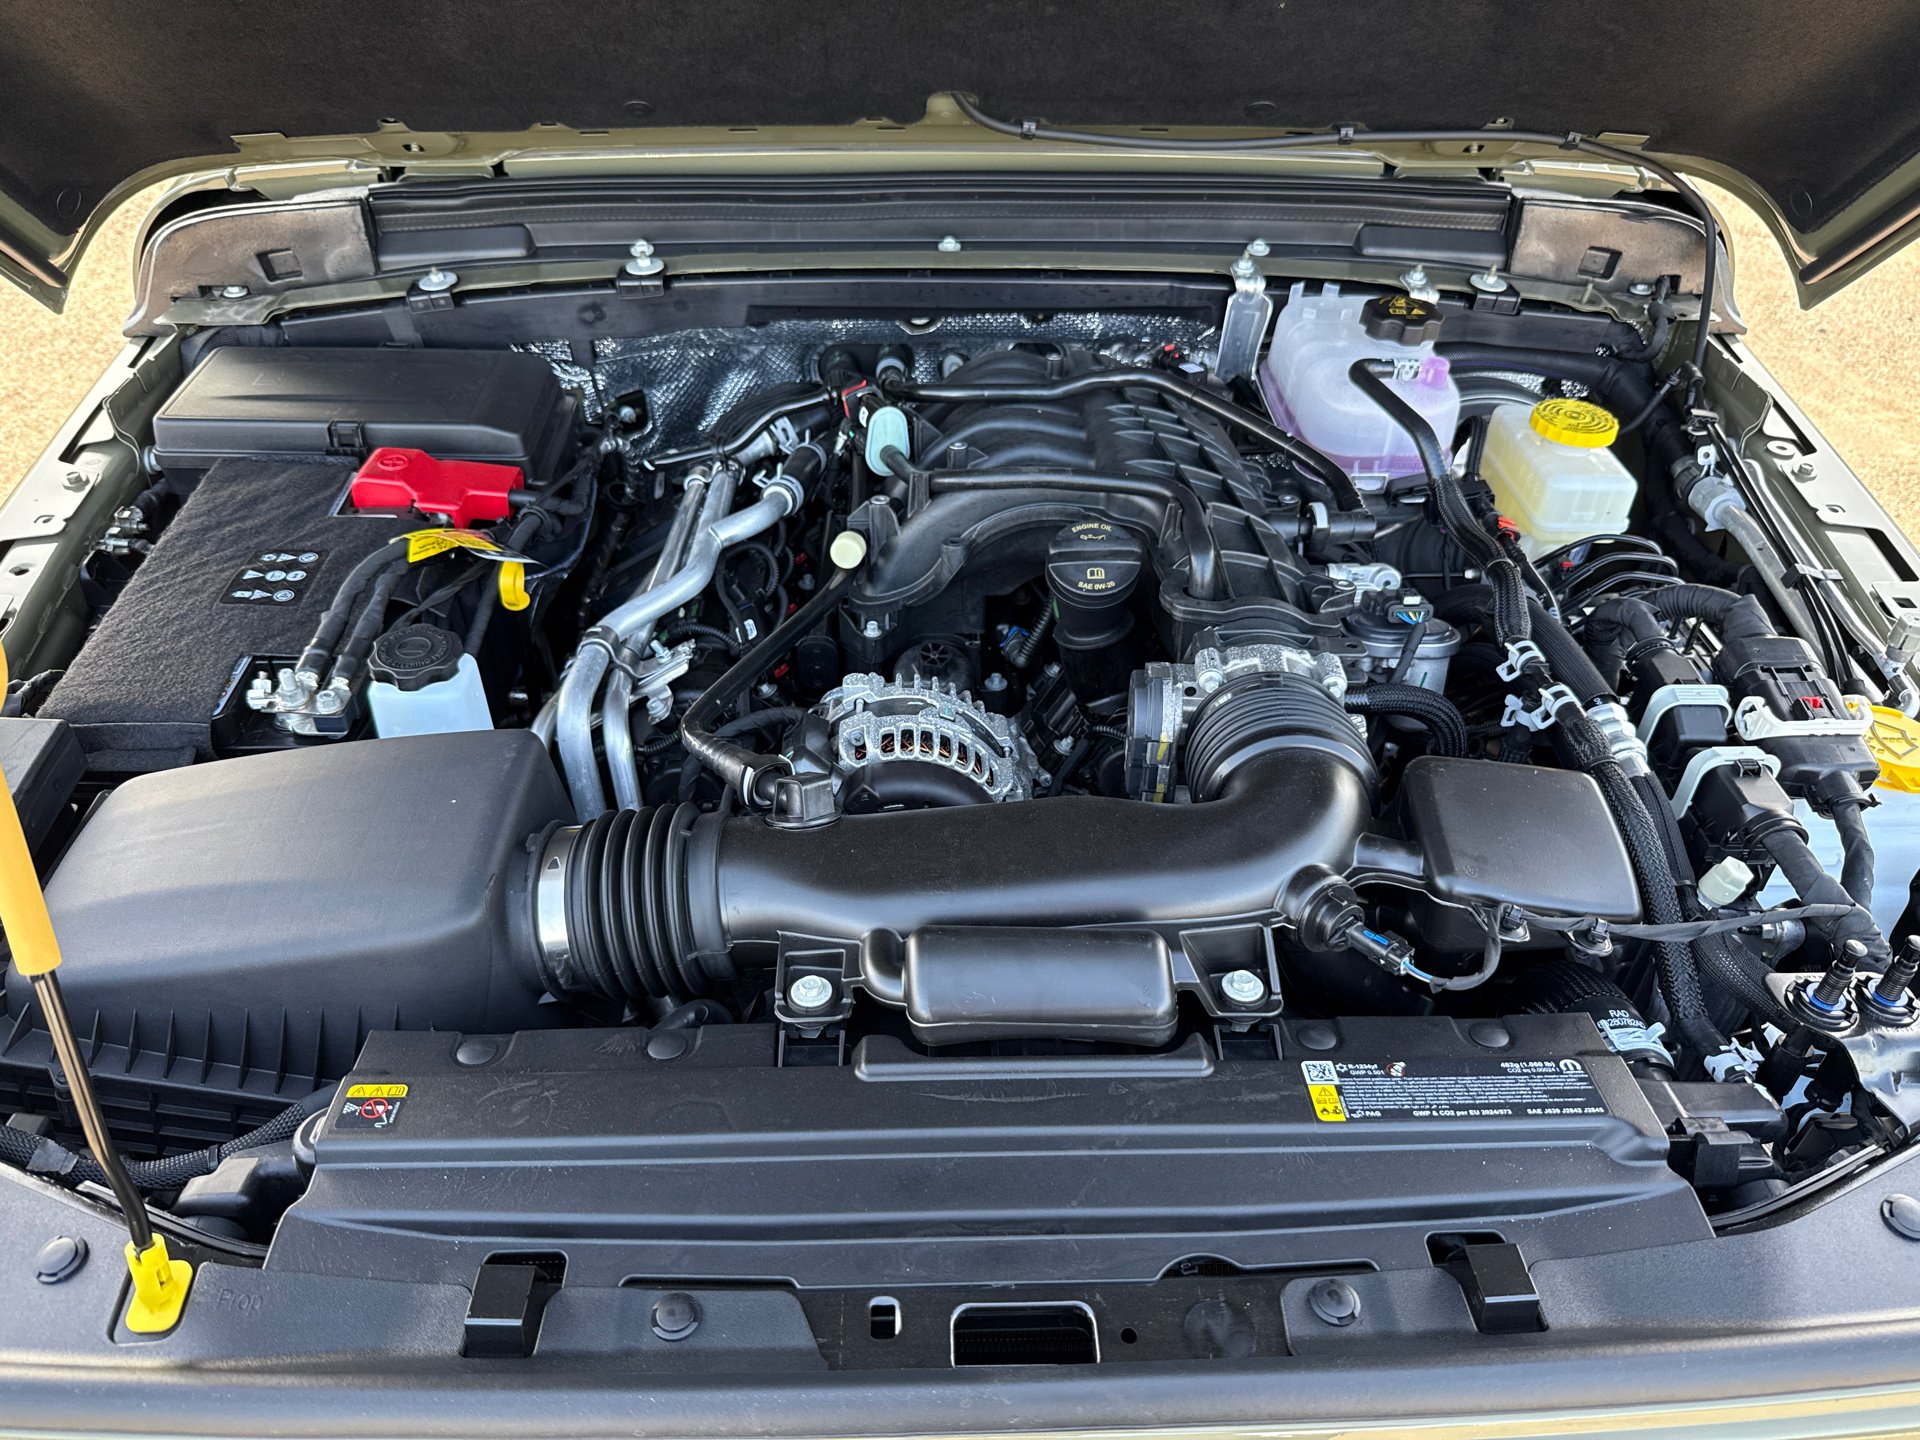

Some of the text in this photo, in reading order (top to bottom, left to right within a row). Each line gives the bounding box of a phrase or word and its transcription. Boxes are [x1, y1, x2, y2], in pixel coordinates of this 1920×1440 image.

[1071, 523, 1112, 533] ENGINE OIL
[1077, 581, 1116, 590] SAE 0W-20
[1608, 1009, 1630, 1018] RAD
